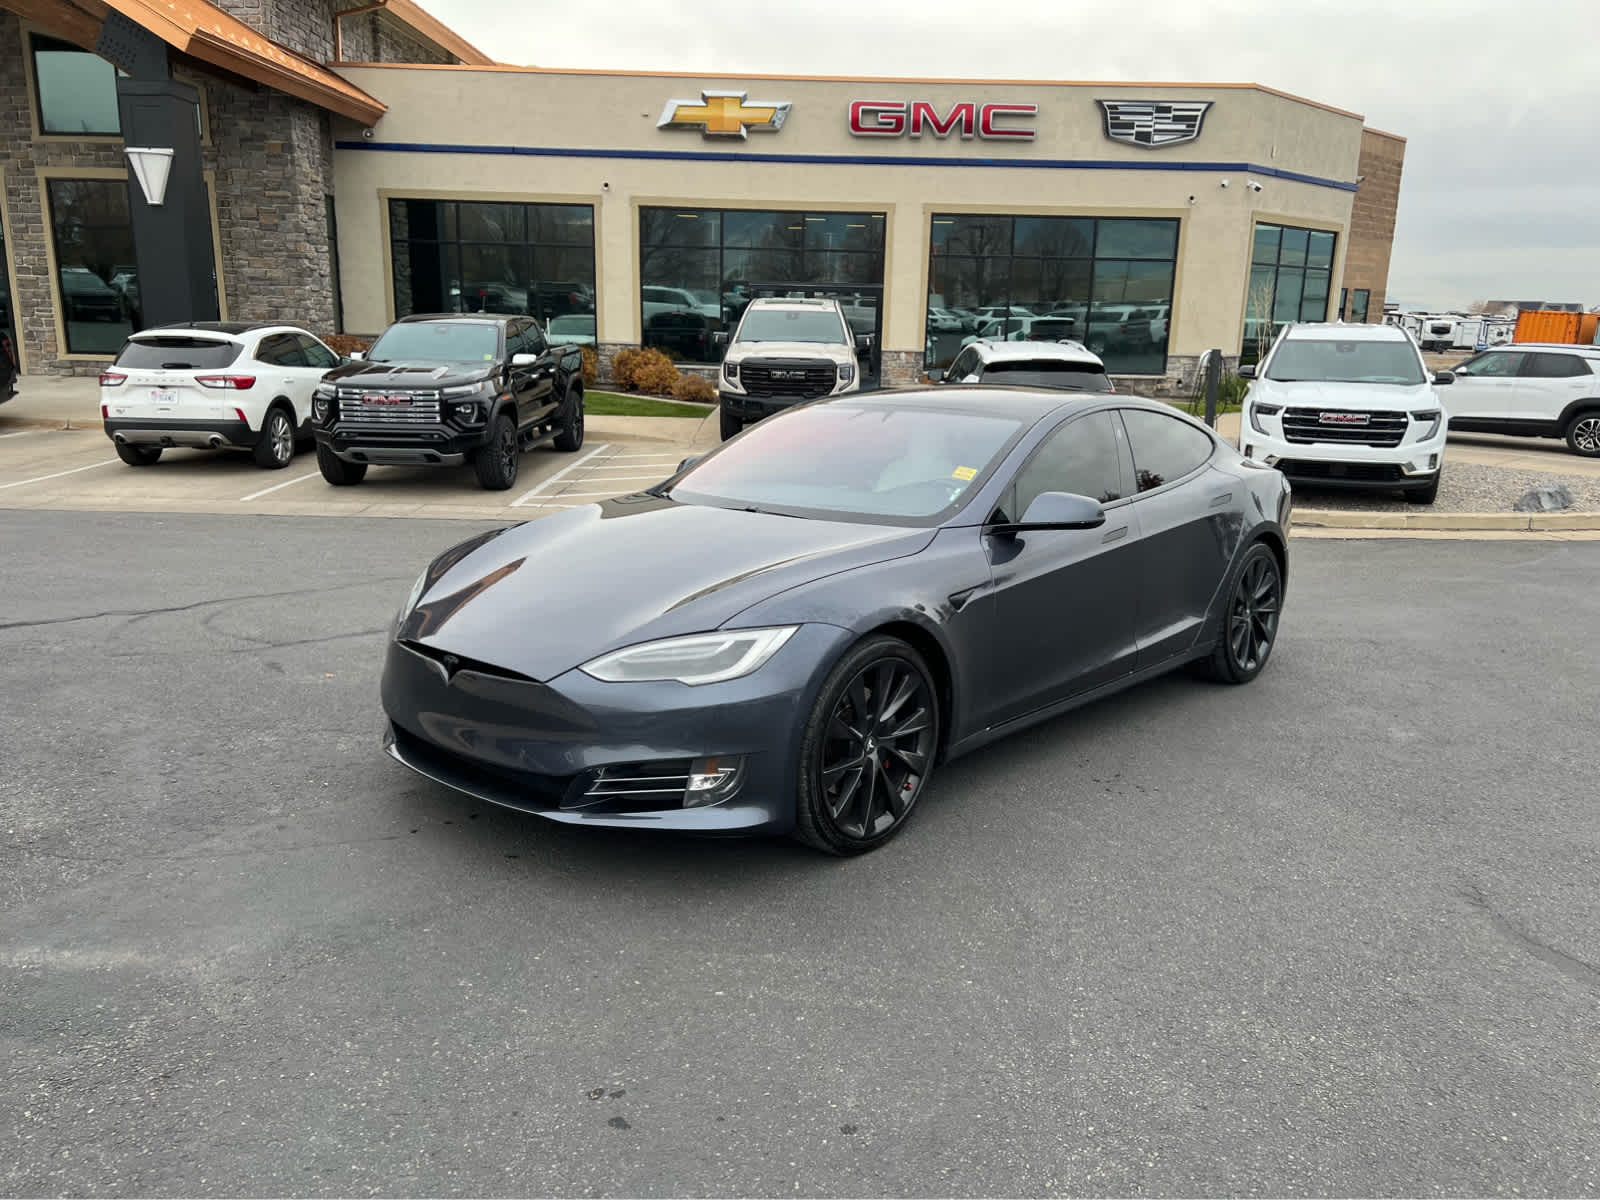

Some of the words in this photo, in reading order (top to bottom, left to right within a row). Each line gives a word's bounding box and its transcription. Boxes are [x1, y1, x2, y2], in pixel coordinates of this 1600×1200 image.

[849, 100, 1038, 140] GMC
[363, 395, 412, 405] GMC
[1321, 413, 1369, 424] GMC
